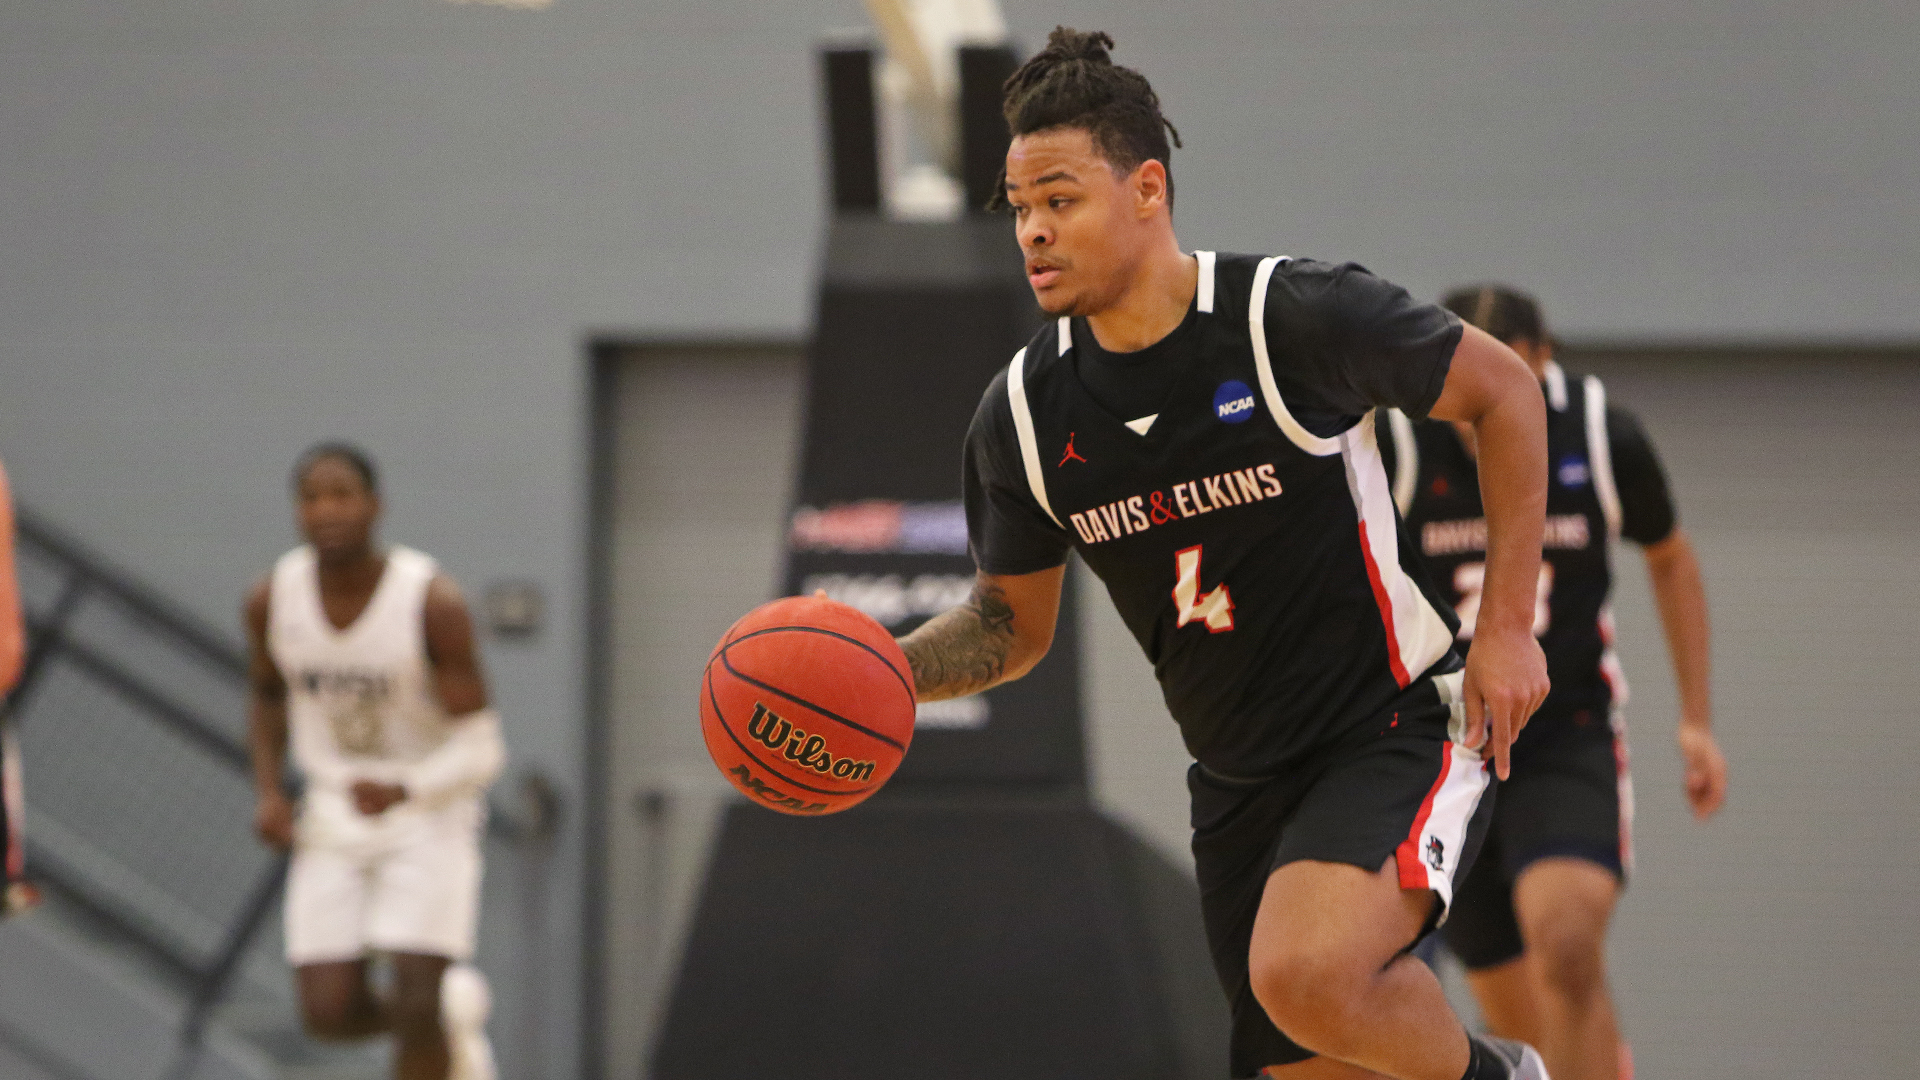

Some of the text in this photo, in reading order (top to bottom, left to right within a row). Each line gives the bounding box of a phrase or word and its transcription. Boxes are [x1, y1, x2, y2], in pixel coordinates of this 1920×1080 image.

[1218, 396, 1254, 417] NCAA
[1171, 544, 1236, 634] 4
[747, 700, 877, 782] Wilson
